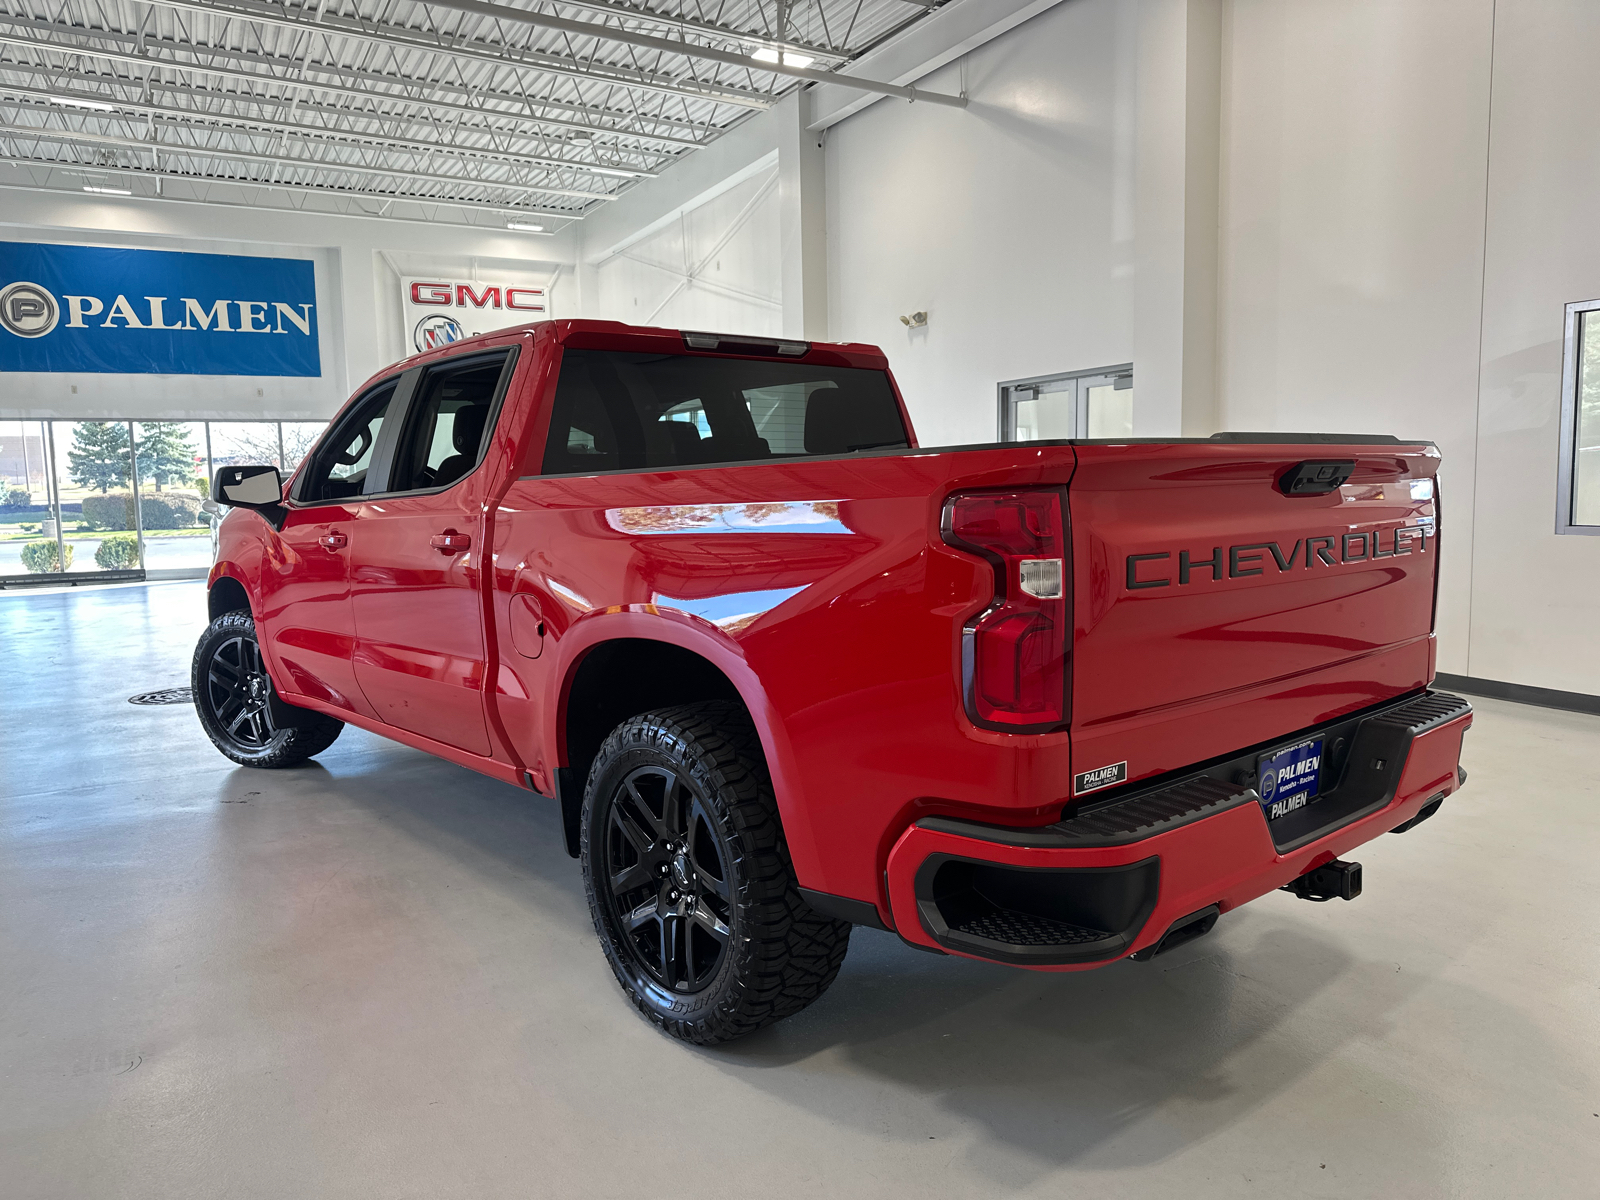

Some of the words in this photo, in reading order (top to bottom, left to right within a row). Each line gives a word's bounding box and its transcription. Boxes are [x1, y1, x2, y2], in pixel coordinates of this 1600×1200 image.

[410, 280, 545, 313] GMC
[62, 294, 314, 336] PALMEN
[1126, 523, 1433, 591] CHEVROLET
[1276, 740, 1312, 758] palmen.com
[1083, 765, 1119, 785] PALMEN
[1277, 755, 1321, 784] PALMEN
[1279, 781, 1297, 794] Kenosha
[1300, 774, 1316, 785] Racine
[1271, 791, 1308, 820] PALMEN
